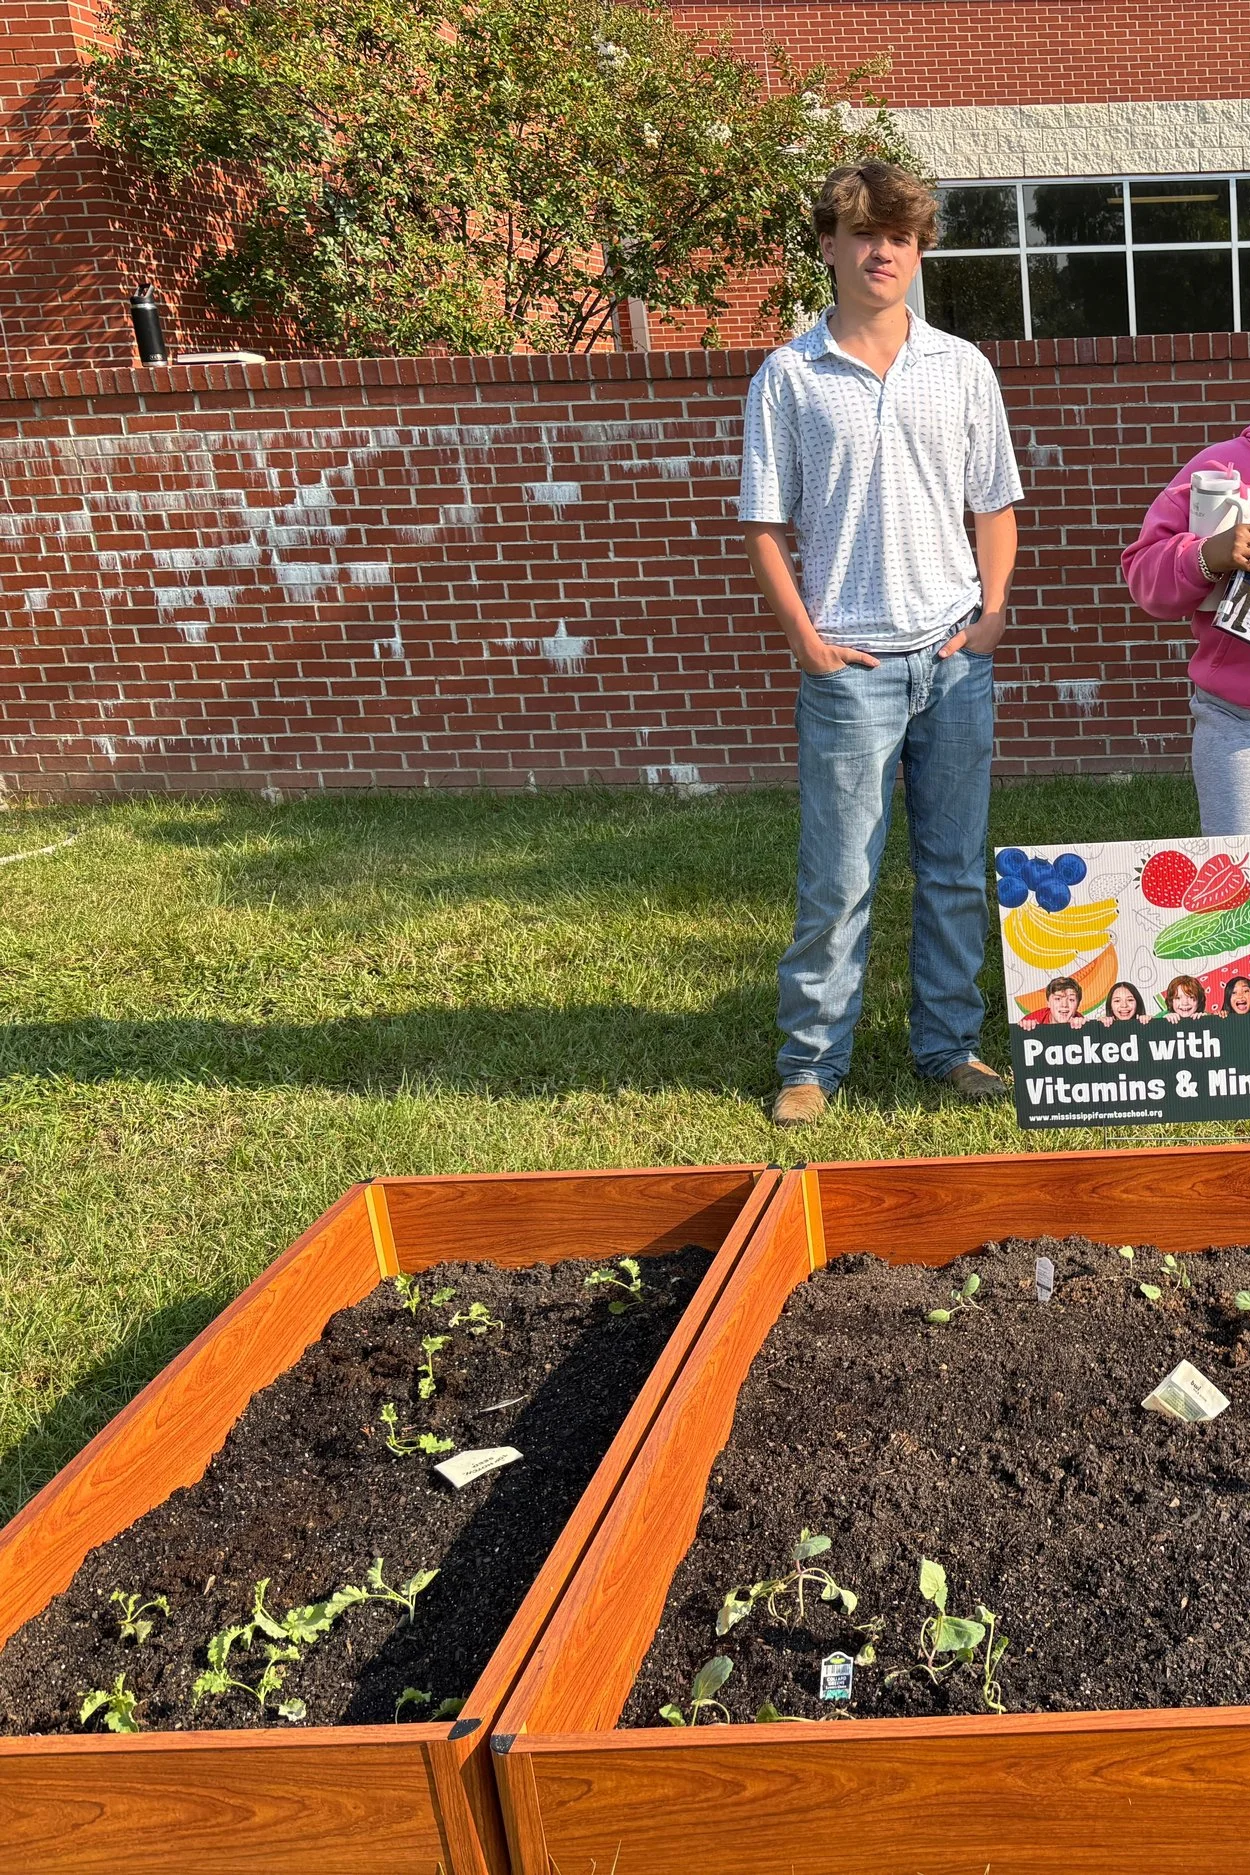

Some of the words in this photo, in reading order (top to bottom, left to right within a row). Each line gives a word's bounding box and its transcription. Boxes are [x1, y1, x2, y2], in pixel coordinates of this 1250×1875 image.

[1023, 1035, 1139, 1066] Packed
[1149, 1030, 1221, 1060] with
[1026, 1074, 1166, 1105] Vitamins
[1176, 1070, 1199, 1098] &
[1028, 1109, 1163, 1122] www.mississippifarmtoschool.org
